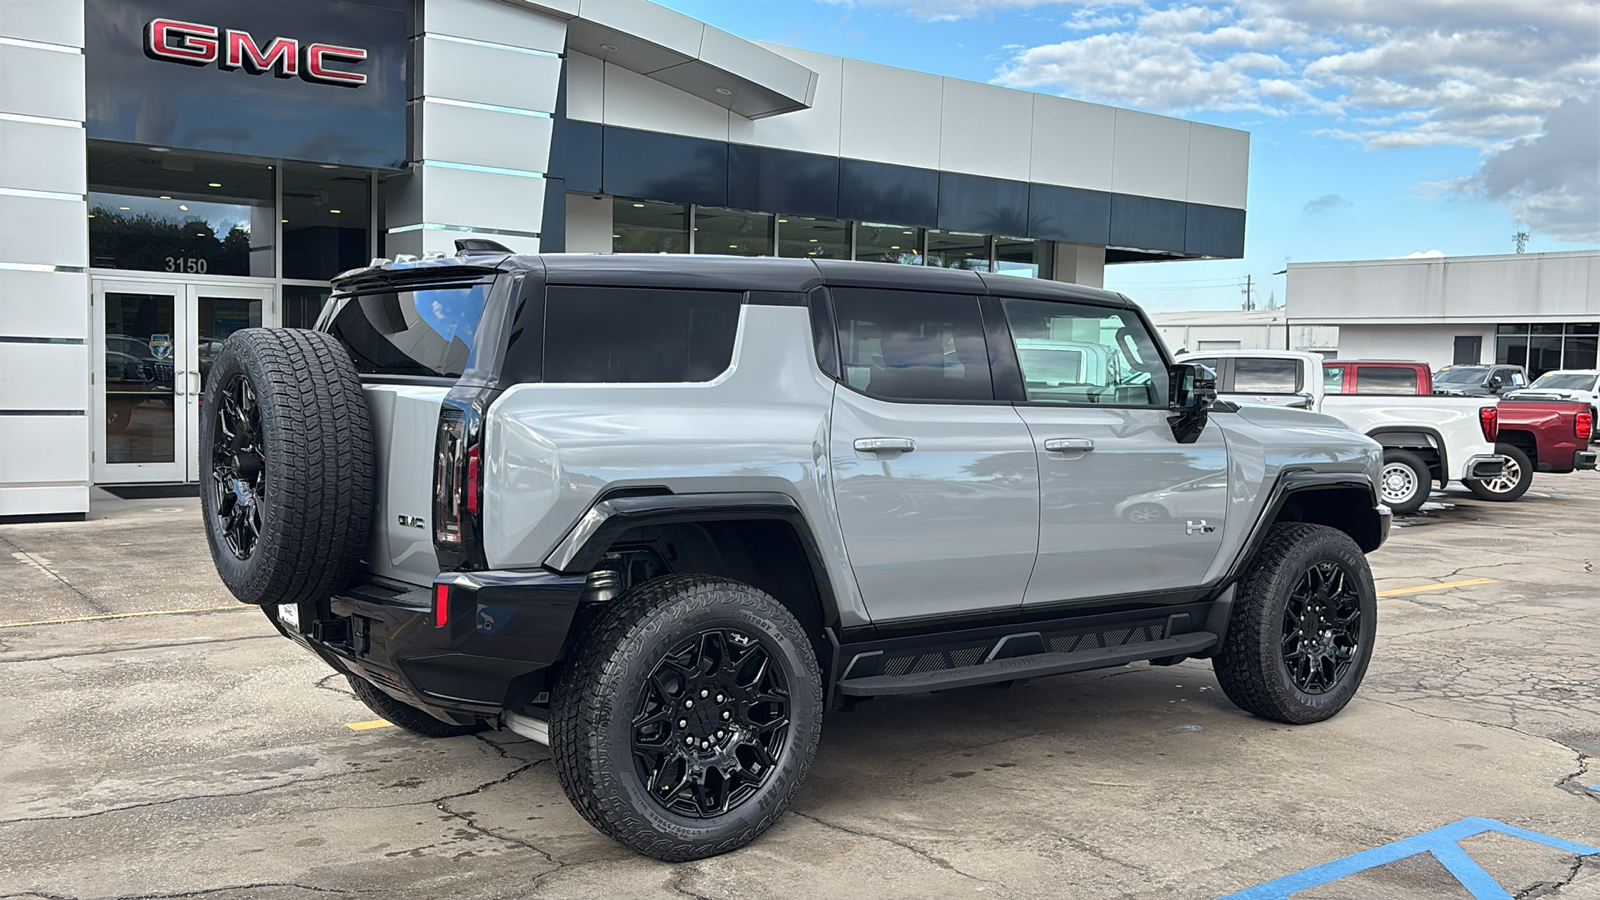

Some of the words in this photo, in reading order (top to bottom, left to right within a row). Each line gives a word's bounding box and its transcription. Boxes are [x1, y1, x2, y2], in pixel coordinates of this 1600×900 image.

[147, 18, 368, 86] GMC
[165, 256, 208, 274] 3150
[398, 514, 425, 530] GMC
[772, 631, 785, 643] AT
